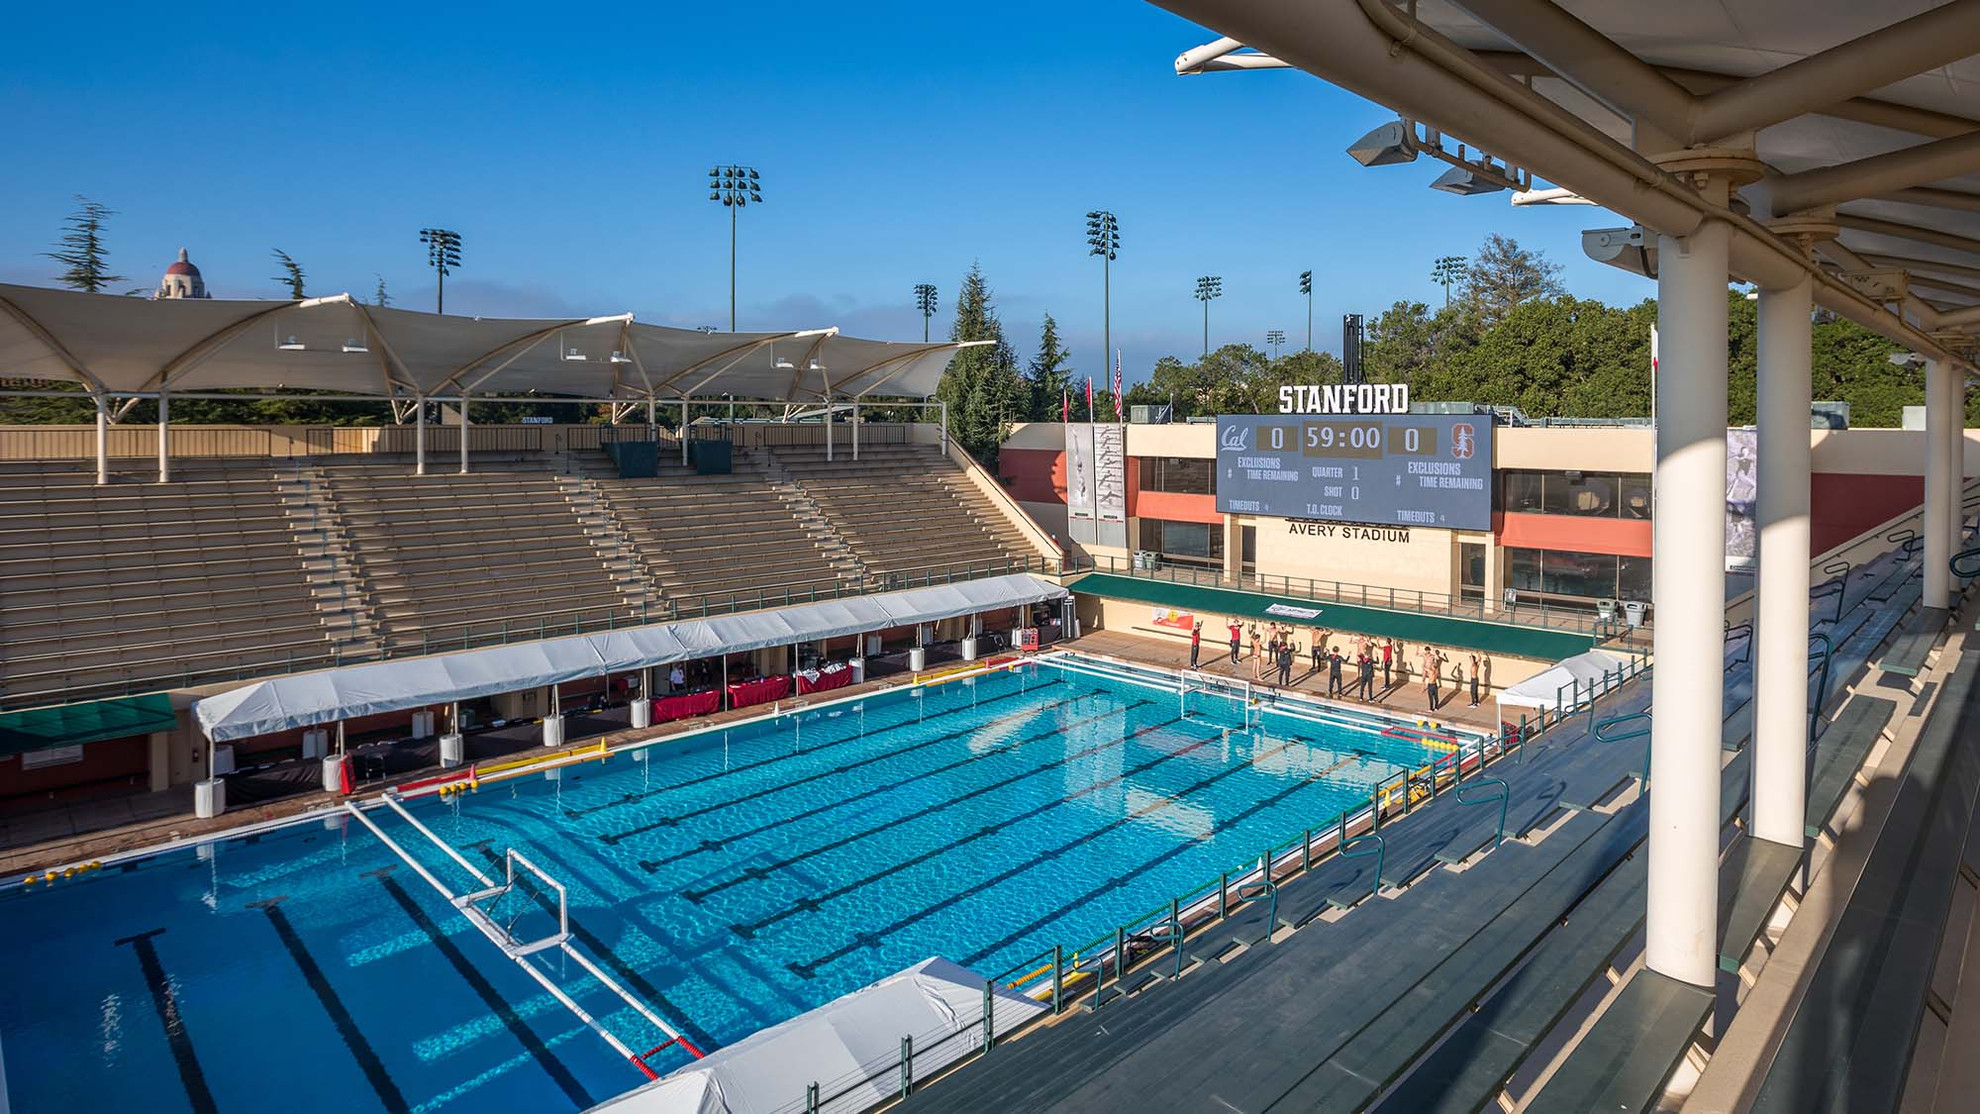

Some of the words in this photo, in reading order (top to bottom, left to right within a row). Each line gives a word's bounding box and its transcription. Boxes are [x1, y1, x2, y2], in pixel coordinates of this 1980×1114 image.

[1280, 384, 1409, 413] STANFORD
[1221, 425, 1249, 451] Cal
[1271, 427, 1284, 449] 0
[1307, 427, 1380, 448] 59:00
[1405, 428, 1419, 452] 0
[1237, 456, 1281, 469] EXCLUSIONS
[1408, 461, 1461, 476] EXCLUSIONS
[1246, 469, 1262, 480] TIME
[1263, 470, 1299, 482] REMAINING
[1312, 466, 1344, 478] QUARTER
[1352, 466, 1360, 481] 1
[1419, 476, 1438, 488] TIME
[1439, 477, 1483, 490] REMAINING
[1324, 486, 1343, 498] SHOT
[1351, 486, 1360, 500] 0
[1229, 499, 1260, 512] TIMEOUTS
[1320, 504, 1343, 516] CLOCK
[1397, 510, 1435, 523] TIMEOUTS
[1289, 523, 1336, 537] AVERY
[1342, 527, 1410, 543] STADIUM
